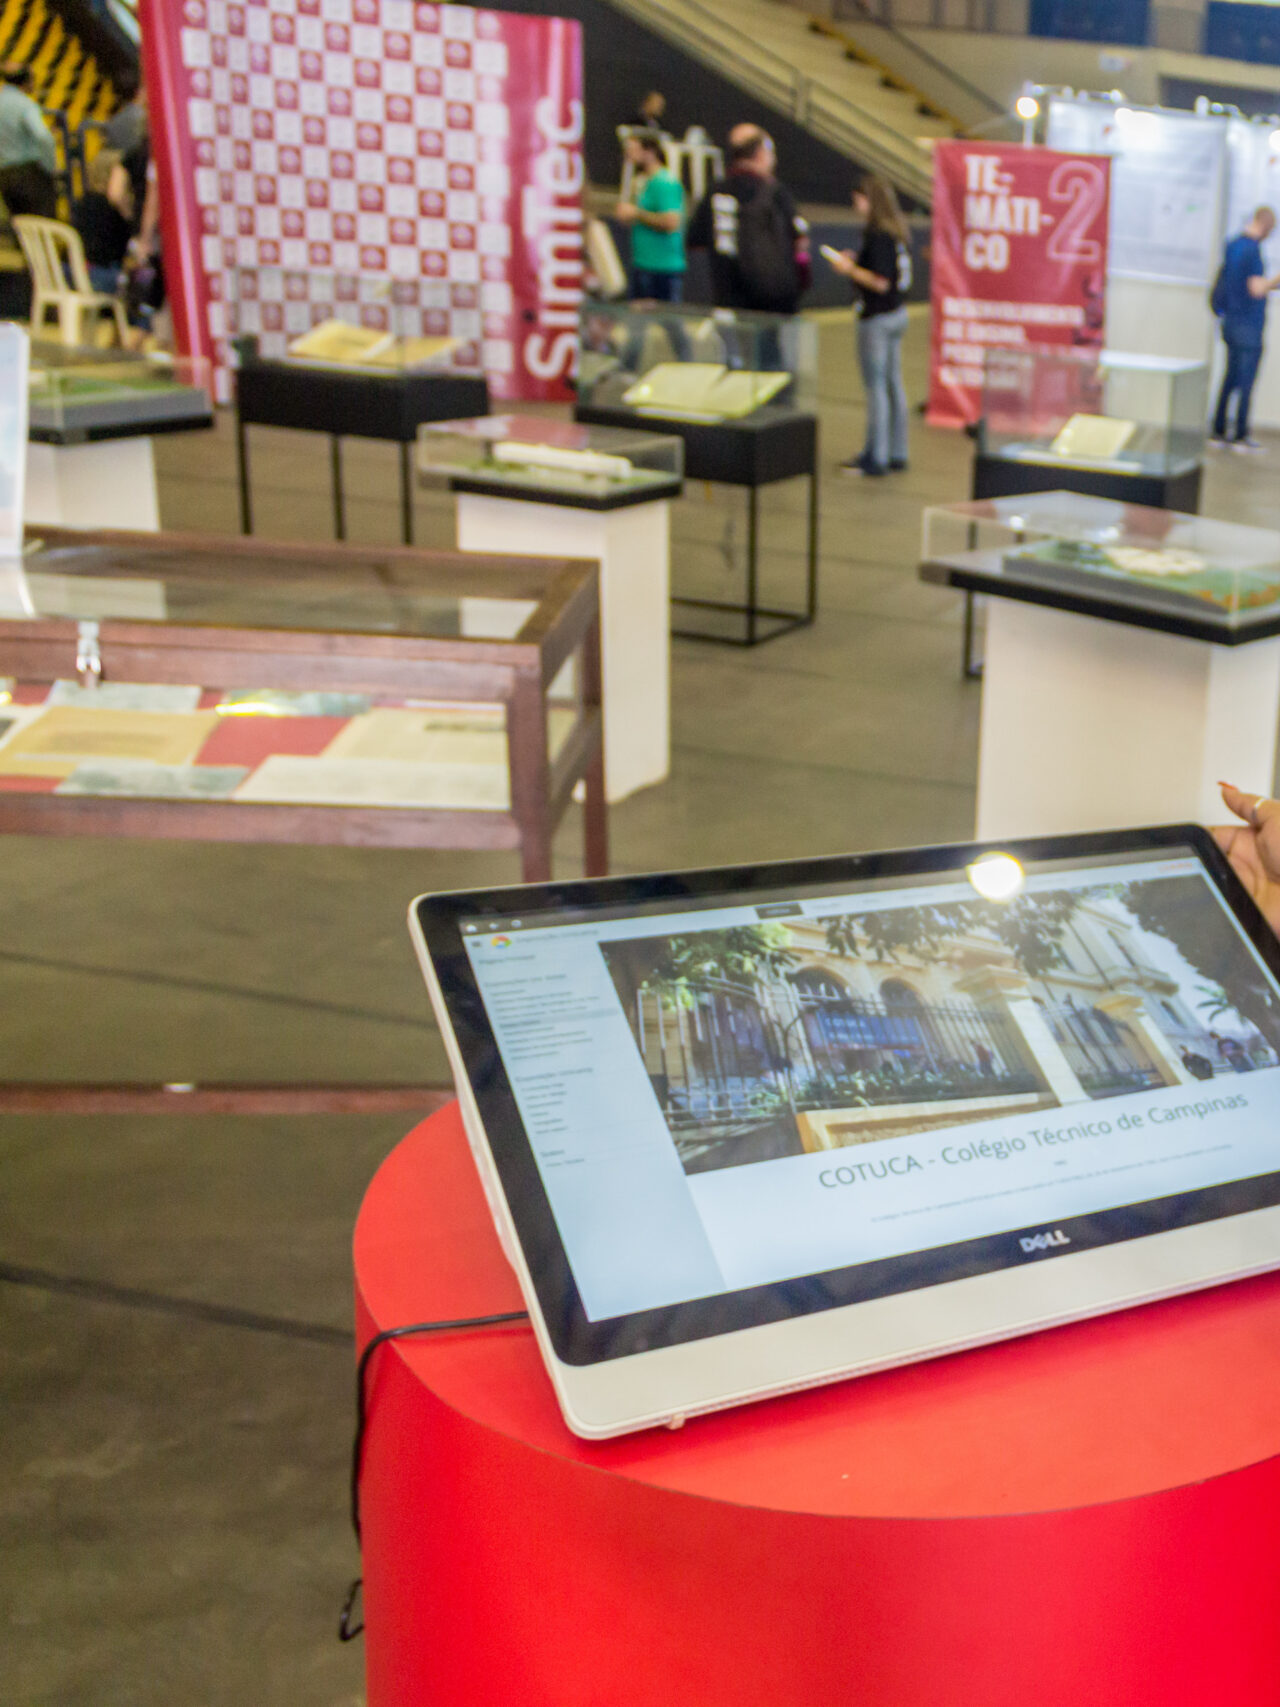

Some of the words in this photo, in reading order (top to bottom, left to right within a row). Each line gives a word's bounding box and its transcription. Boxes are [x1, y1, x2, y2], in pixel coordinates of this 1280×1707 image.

[1047, 160, 1106, 263] 2
[964, 232, 1009, 273] CO
[818, 1155, 925, 1189] COTUCA
[941, 1136, 1027, 1164] Colégio
[1028, 1119, 1113, 1148] Técnico
[1116, 1112, 1145, 1131] de
[1148, 1093, 1249, 1124] Campinas
[1019, 1229, 1071, 1252] DELL
